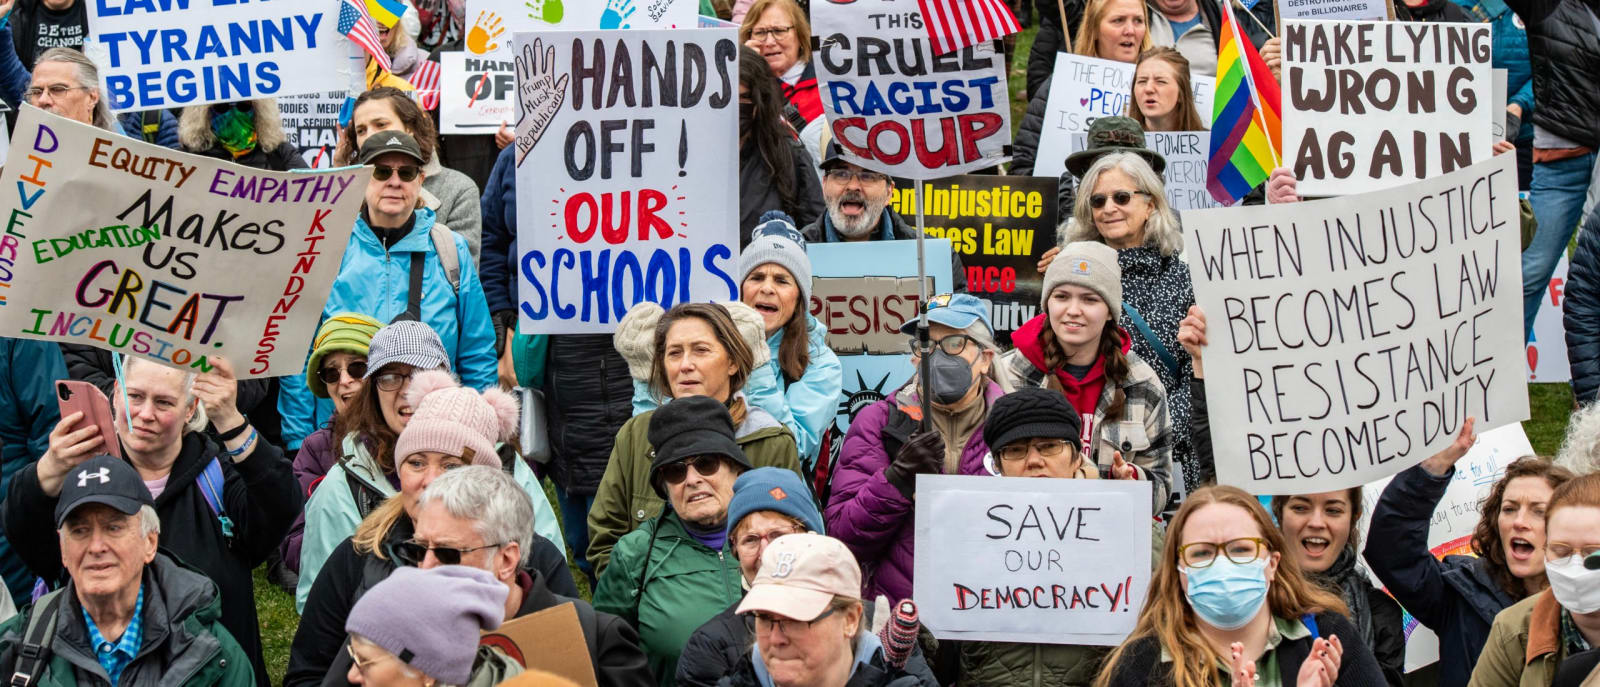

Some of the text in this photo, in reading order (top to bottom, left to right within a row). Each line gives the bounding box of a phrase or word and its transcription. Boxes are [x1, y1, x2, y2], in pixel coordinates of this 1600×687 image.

[1311, 3, 1368, 16] BILLIONAIRES
[37, 36, 84, 48] CHANGE
[39, 23, 83, 37] BE THE
[99, 13, 323, 68] TYRANNY
[1286, 23, 1490, 66] MAKE LYING
[465, 58, 514, 72] HAN
[520, 75, 551, 95] Trump
[571, 38, 737, 111] HANDS
[1071, 60, 1134, 89] THE POW
[106, 61, 281, 110] BEGINS
[465, 74, 514, 101] OF
[525, 88, 554, 114] Musk
[828, 76, 998, 116] RACIST
[1089, 87, 1131, 116] PEOP
[1289, 66, 1477, 115] WRONG
[282, 117, 338, 128] CIAL SECURIT
[515, 87, 564, 153] Republicans
[1057, 110, 1080, 131] IS
[564, 118, 655, 181] OFF
[832, 112, 1004, 169] COUP
[1155, 133, 1202, 155] POWER
[1294, 127, 1472, 180] AGAIN
[89, 137, 197, 188] EQUITY
[209, 168, 356, 204] EMPATHY
[924, 183, 1043, 220] Injustice
[564, 188, 675, 245] OUR
[1195, 168, 1506, 281] WHEN INJUSTICE
[32, 224, 162, 264] EDUCATION
[983, 222, 1034, 256] Law
[142, 241, 199, 280] US
[250, 208, 331, 375] KINDNESS
[520, 244, 739, 324] SCHOOLS
[1224, 240, 1499, 354] BECOMES LAW
[23, 308, 214, 373] INCLUSION
[1243, 308, 1494, 424] RESISTANCE
[1247, 368, 1496, 480] BECOMES DUTY
[986, 504, 1101, 542] SAVE
[1005, 549, 1063, 572] OUR
[952, 575, 1133, 613] DEMOCRACY!
